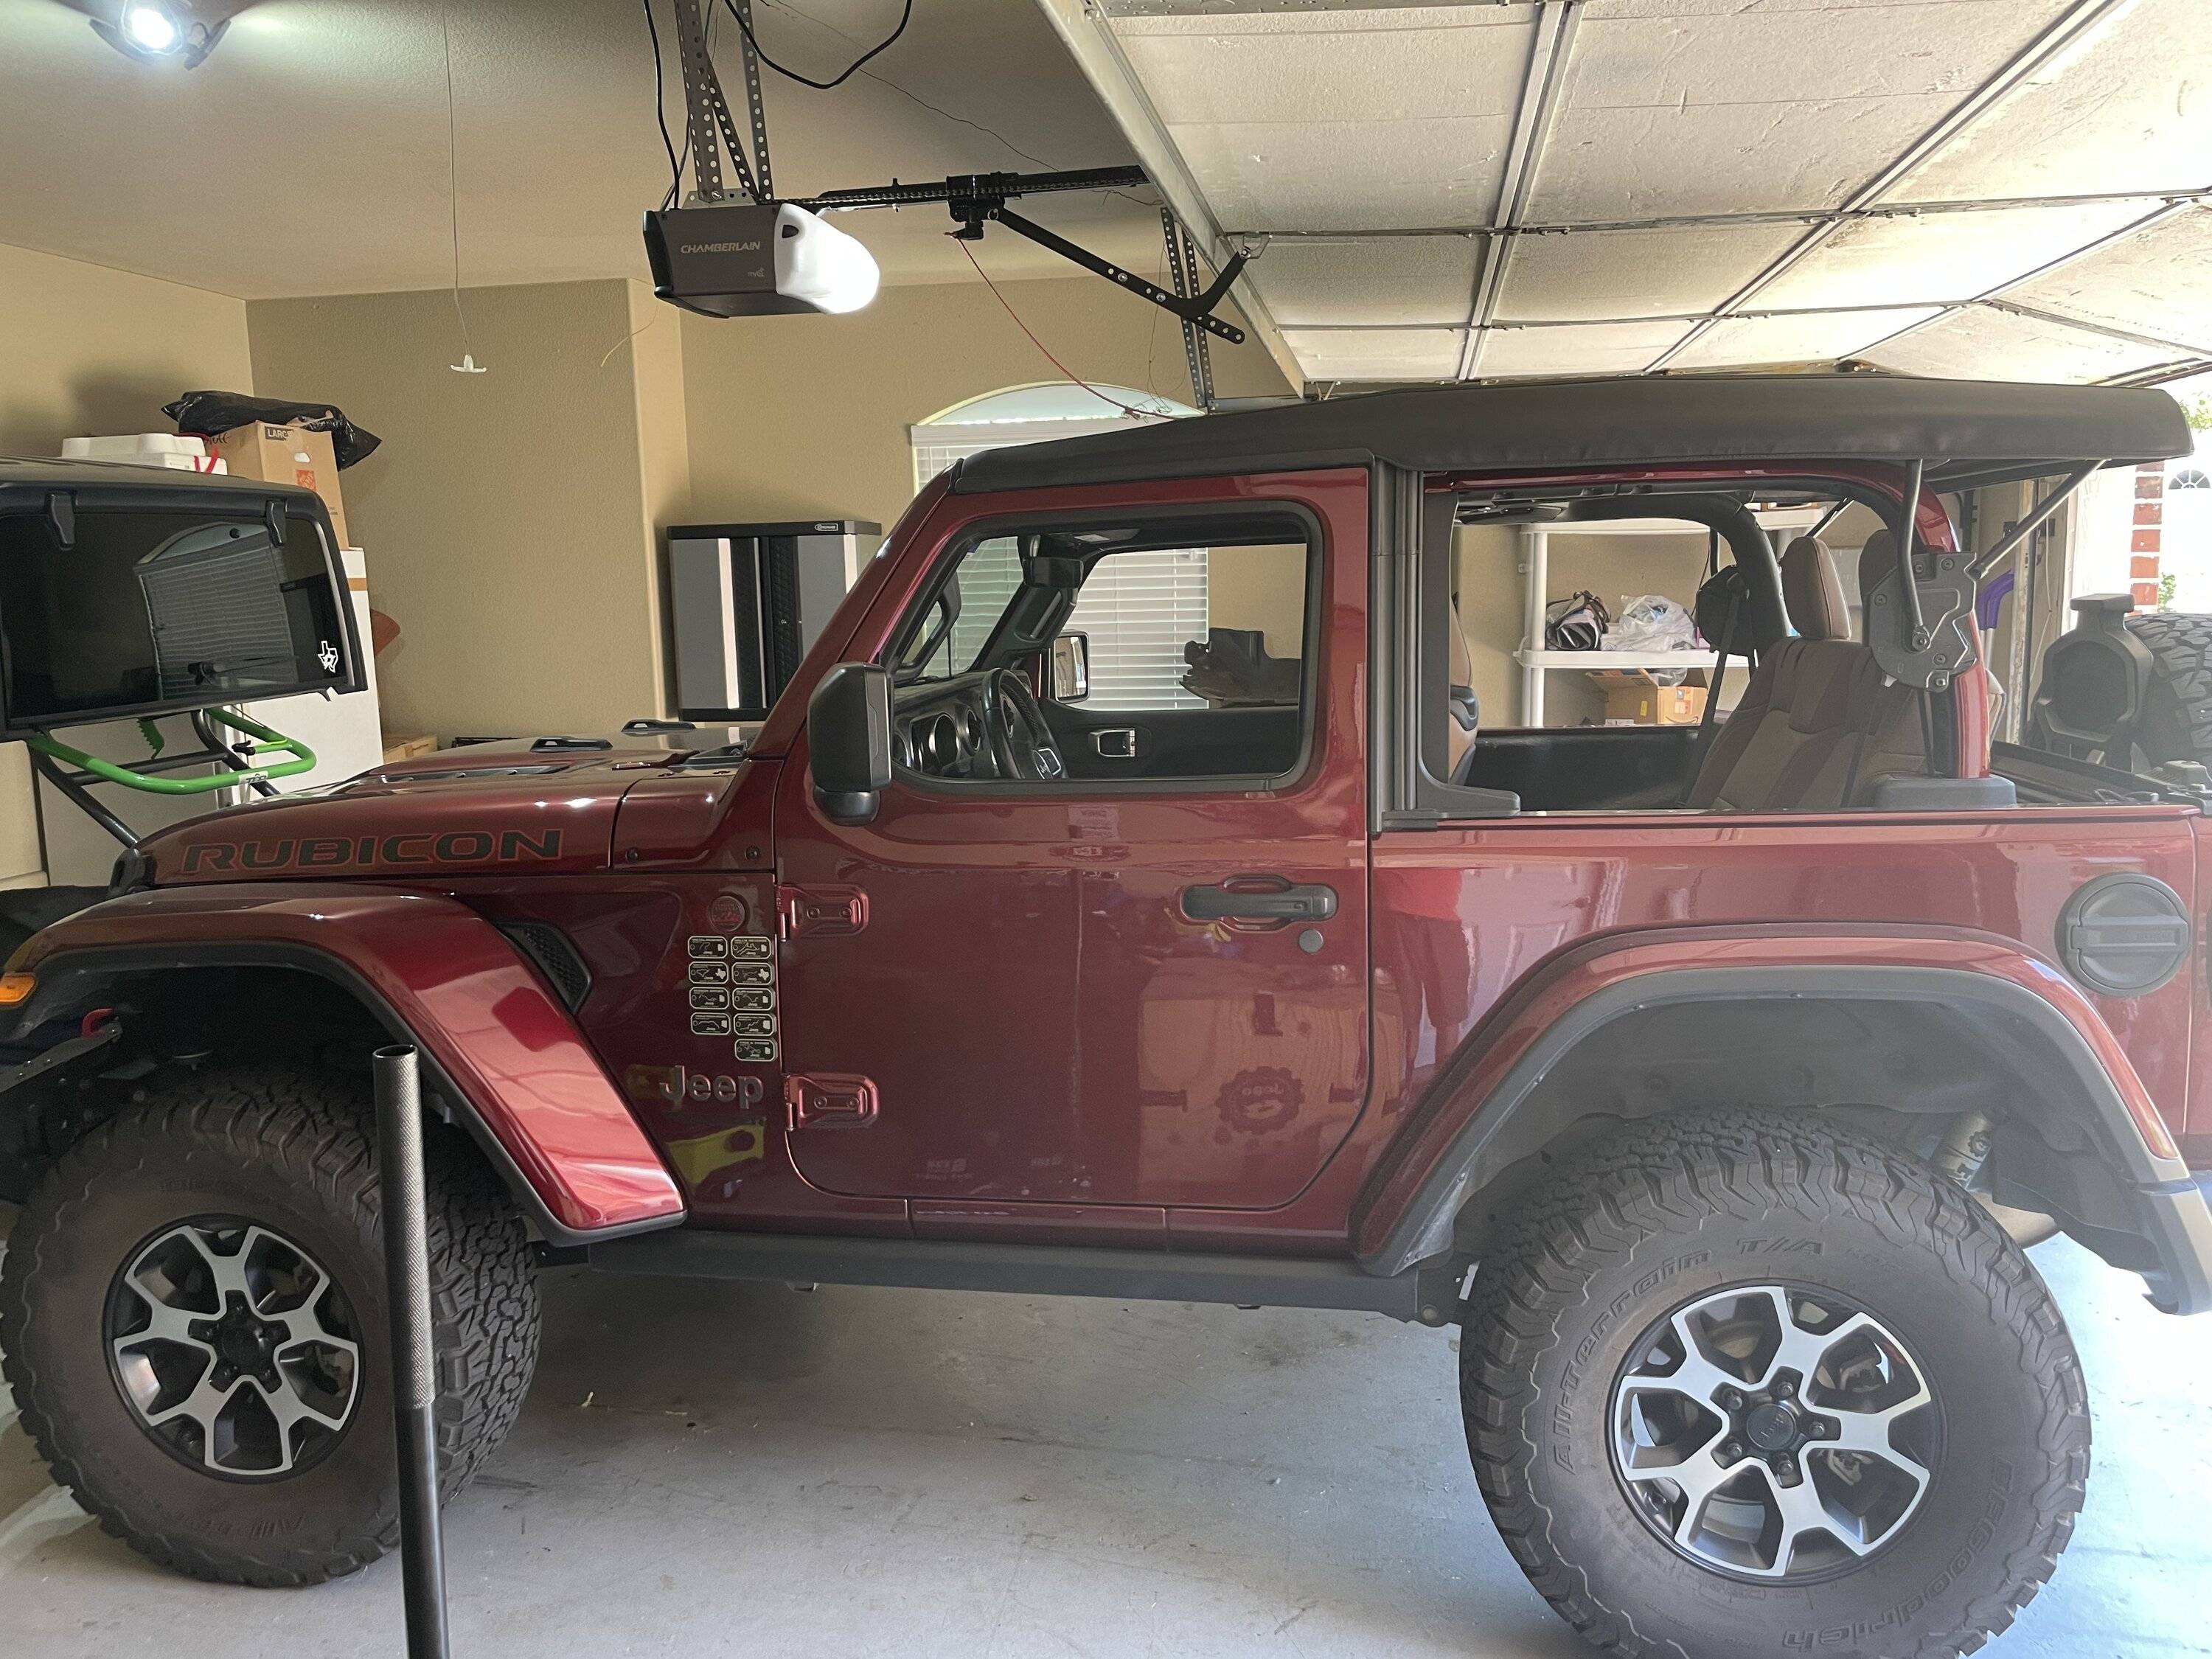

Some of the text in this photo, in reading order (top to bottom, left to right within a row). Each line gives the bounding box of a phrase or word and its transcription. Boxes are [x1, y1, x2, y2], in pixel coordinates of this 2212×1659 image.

[681, 242, 760, 254] CHAMBERLAIN
[182, 829, 564, 874] RUBICON
[660, 1065, 763, 1109] Jeep
[1554, 1249, 1712, 1475] All-Terrain
[1736, 1237, 1826, 1256] T/A
